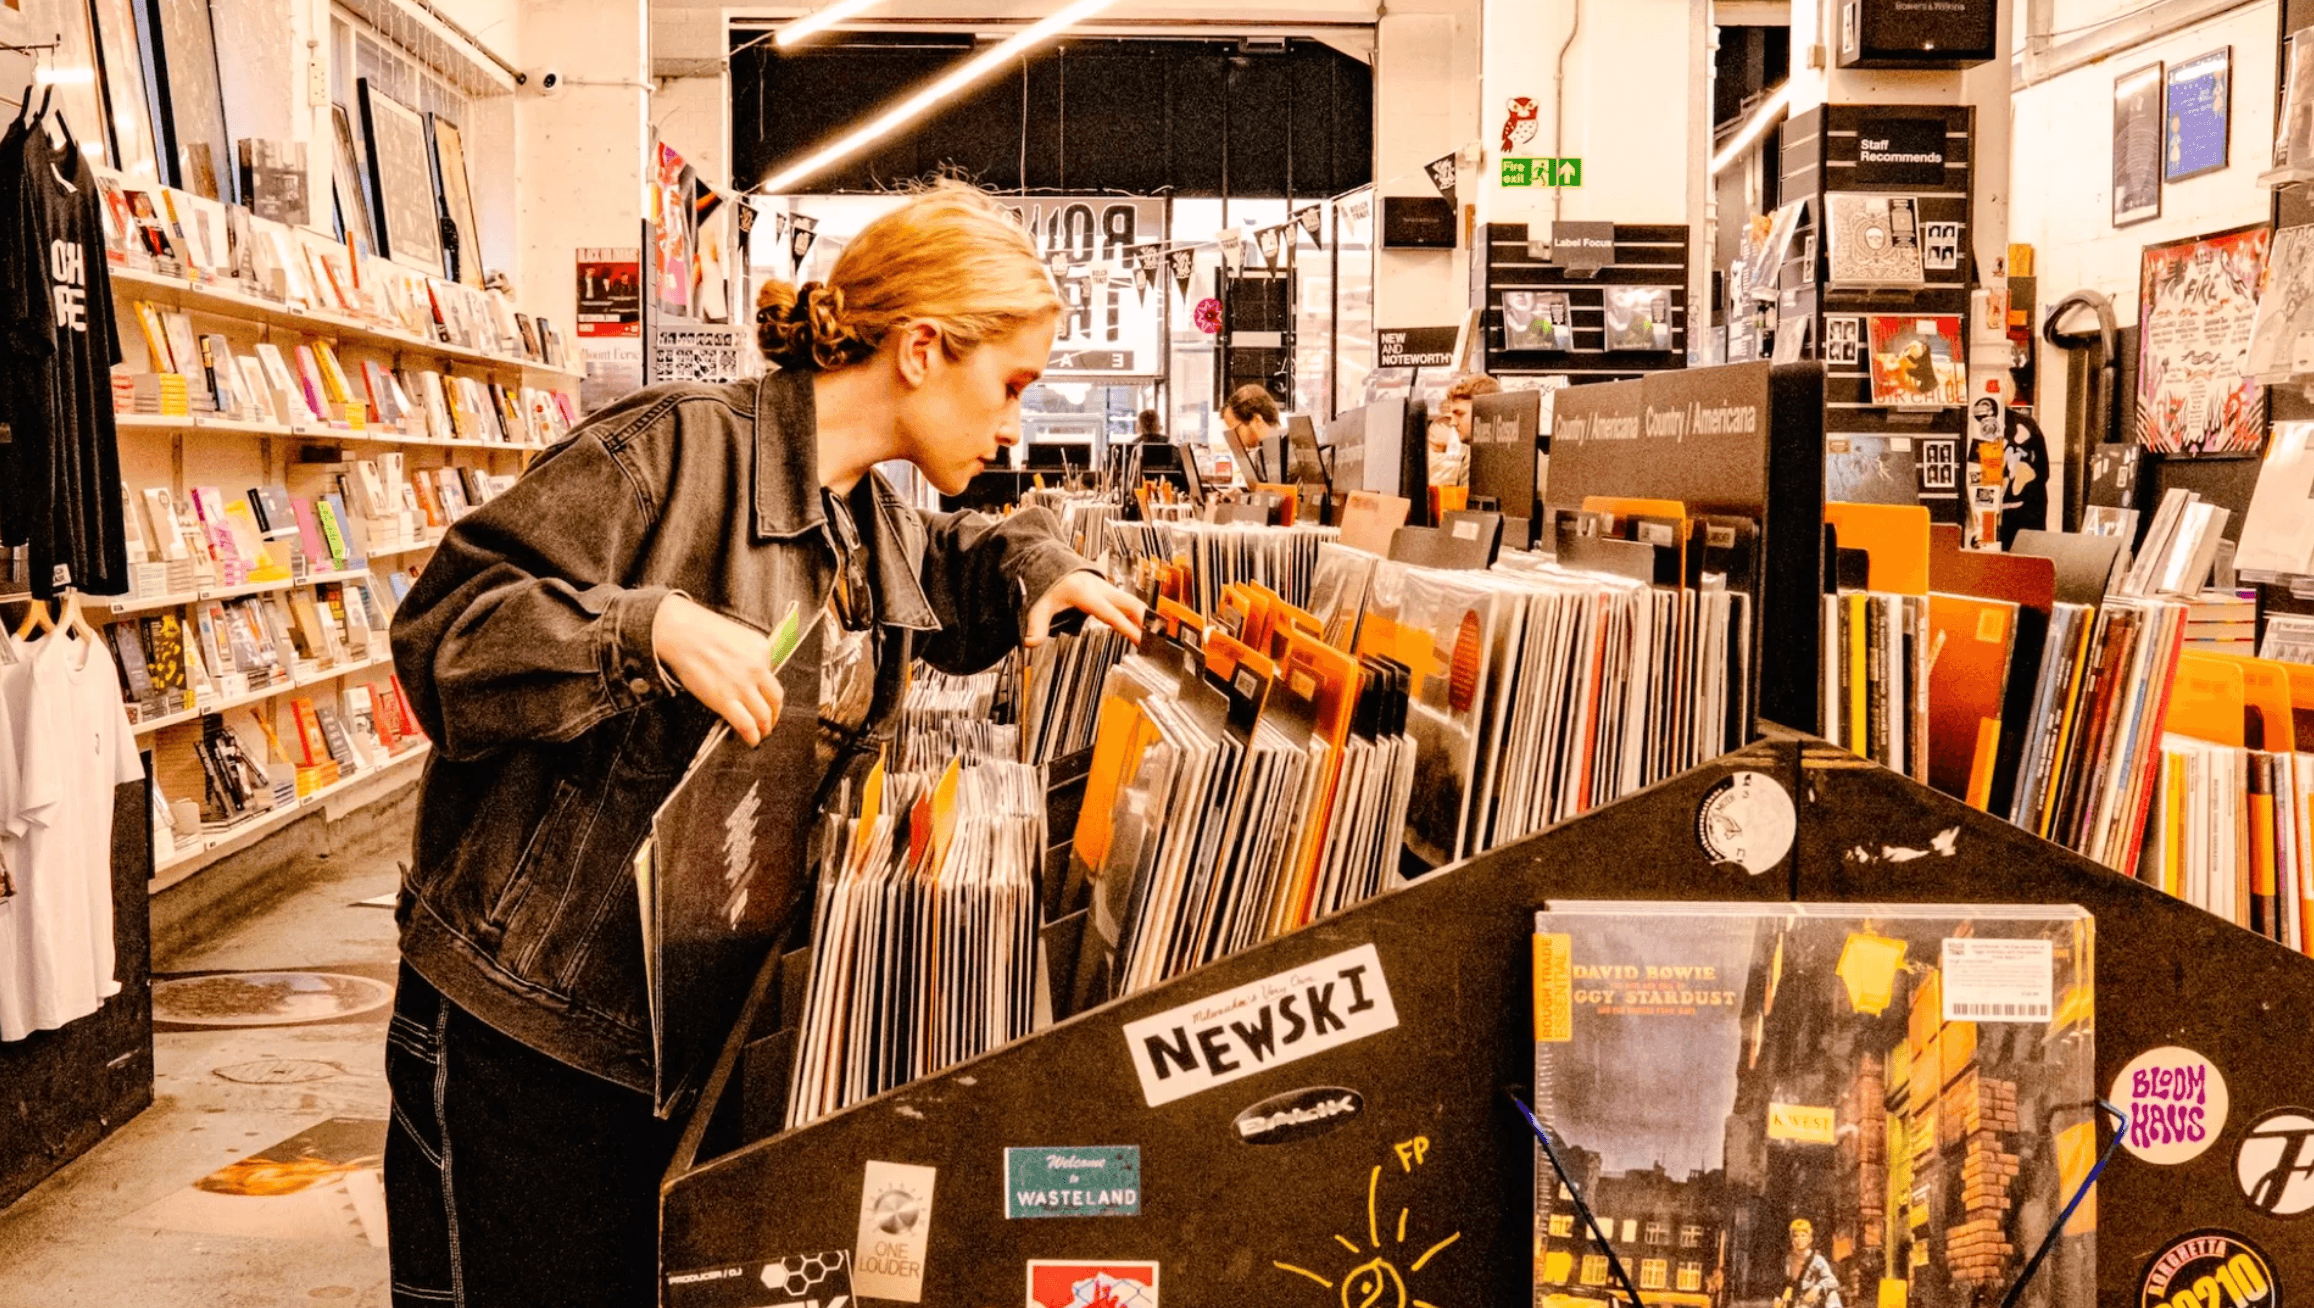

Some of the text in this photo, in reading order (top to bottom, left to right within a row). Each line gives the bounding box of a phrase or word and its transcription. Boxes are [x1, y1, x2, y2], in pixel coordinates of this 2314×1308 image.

[1860, 139, 1890, 150] Staff
[1860, 151, 1942, 163] Recommends
[1503, 161, 1525, 172] Fire
[1503, 173, 1525, 183] exit
[1553, 237, 1612, 248] Label Focus
[1381, 333, 1406, 344] NEW
[1381, 344, 1403, 355] AND
[1381, 353, 1454, 366] NOTEWORTHY
[1555, 413, 1587, 447] Country
[1591, 410, 1639, 441] Americana
[1645, 405, 1686, 444] Country
[1692, 399, 1757, 434] Americana
[1472, 415, 1492, 443] Blues
[1497, 412, 1520, 449] Gospel
[1572, 965, 1717, 981] DAVID BOWIE
[1541, 938, 1553, 1038] ROUGH TRADE
[1554, 950, 1568, 1038] ESSENTIAL
[1573, 990, 1737, 1006] GGY STARDUST
[1144, 964, 1375, 1081] NEWSKI
[2131, 1064, 2206, 1105] BLOOM
[2131, 1102, 2206, 1149] HAUS
[1045, 1154, 1106, 1169] Welcome
[1394, 1136, 1429, 1172] FP
[1068, 1174, 1080, 1184] to
[1016, 1189, 1137, 1206] WASTELAND
[874, 1241, 909, 1259] ONE
[668, 1269, 723, 1285] PRODUCER
[729, 1267, 743, 1278] DJ
[859, 1257, 920, 1279] LOUDER
